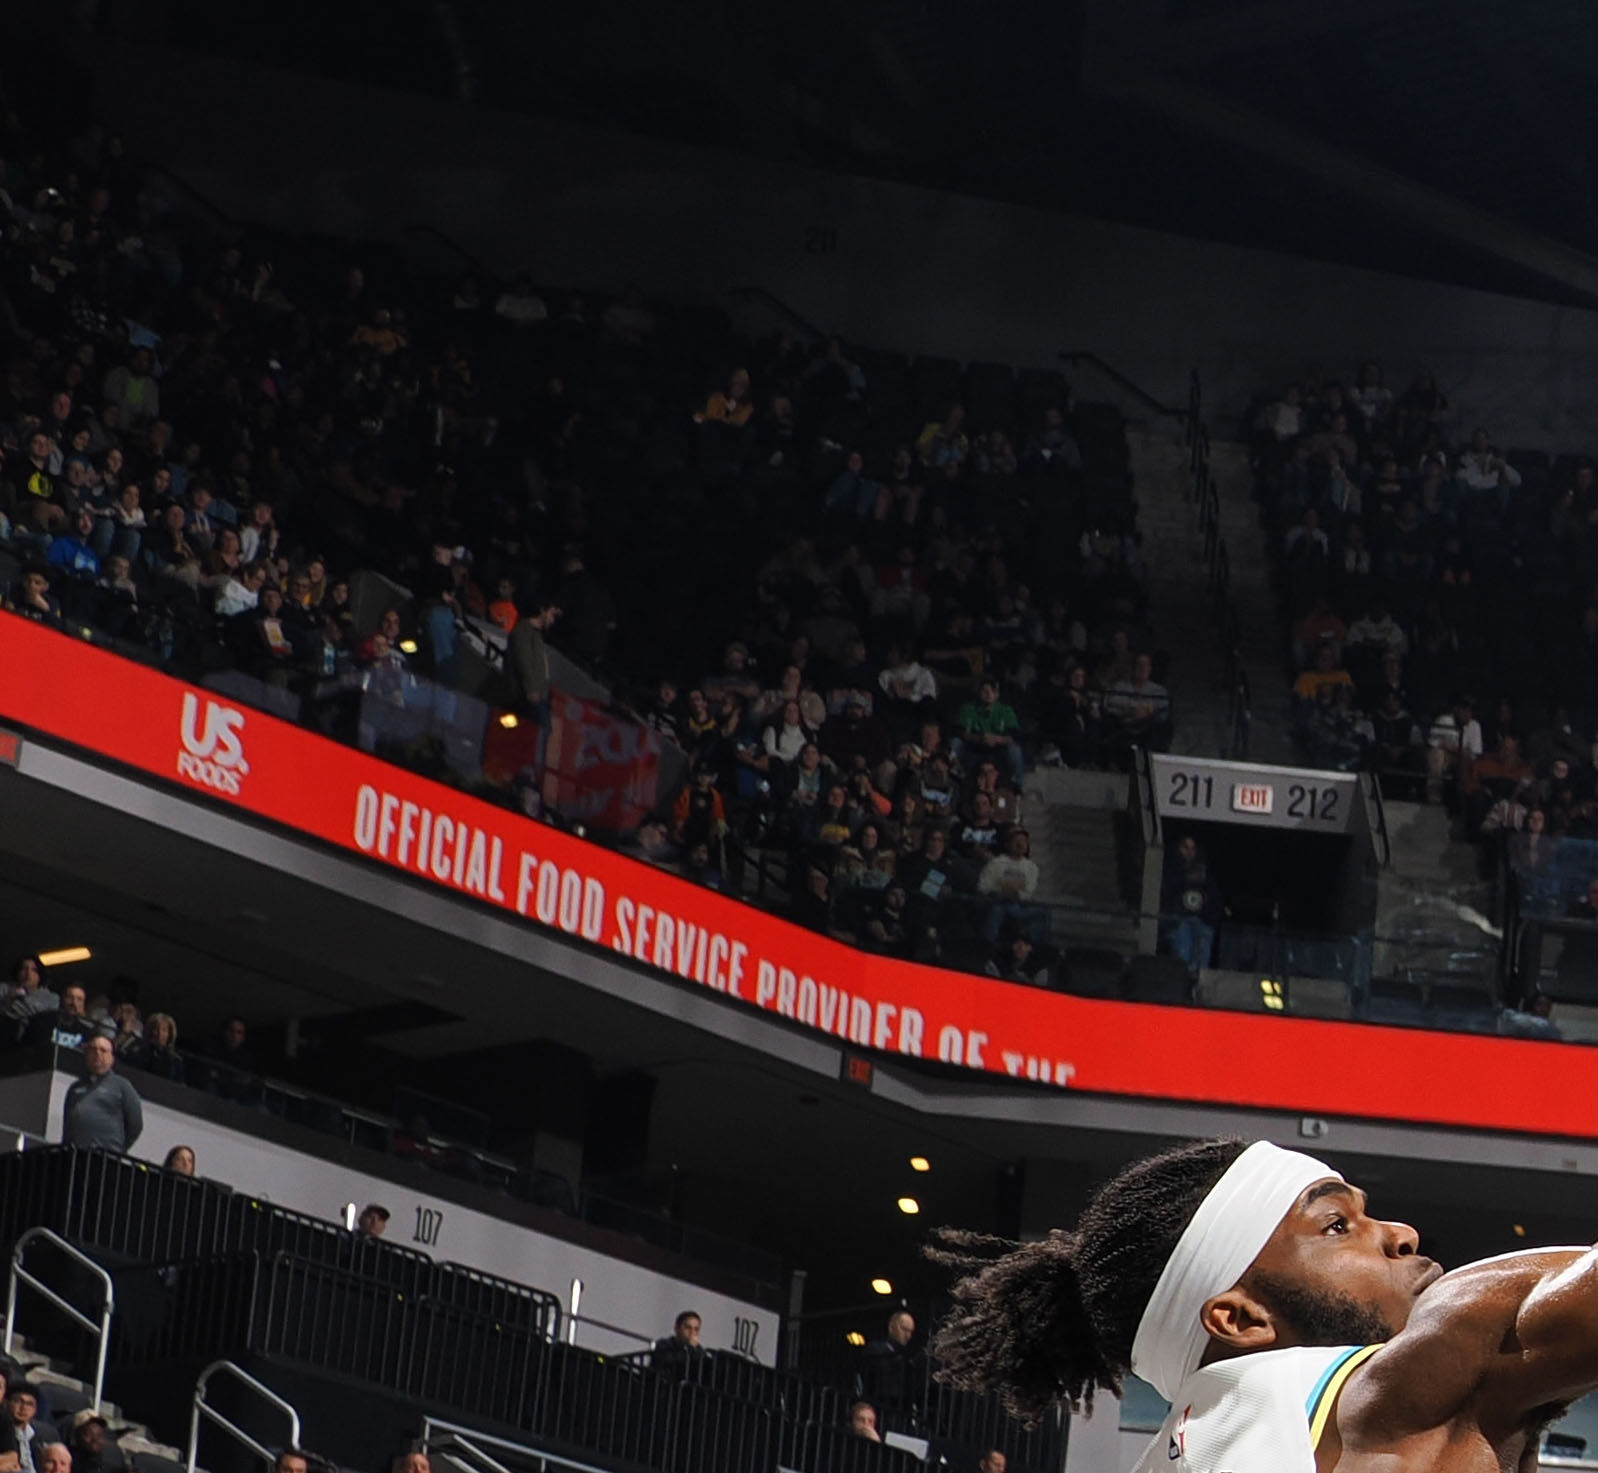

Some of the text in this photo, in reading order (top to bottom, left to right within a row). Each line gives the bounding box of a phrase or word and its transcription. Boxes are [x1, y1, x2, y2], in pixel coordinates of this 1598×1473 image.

[176, 750, 241, 796] FOODS
[1169, 772, 1213, 808] 211
[1240, 785, 1268, 809] EXIT
[1287, 784, 1339, 820] 212
[354, 784, 505, 901] OFFICIAL
[516, 852, 605, 942] FOOD
[612, 896, 749, 999] SERVICE
[756, 957, 925, 1057] PROVIDER
[939, 1024, 989, 1069] OF
[412, 1205, 444, 1247] 107
[731, 1315, 760, 1357] 107
